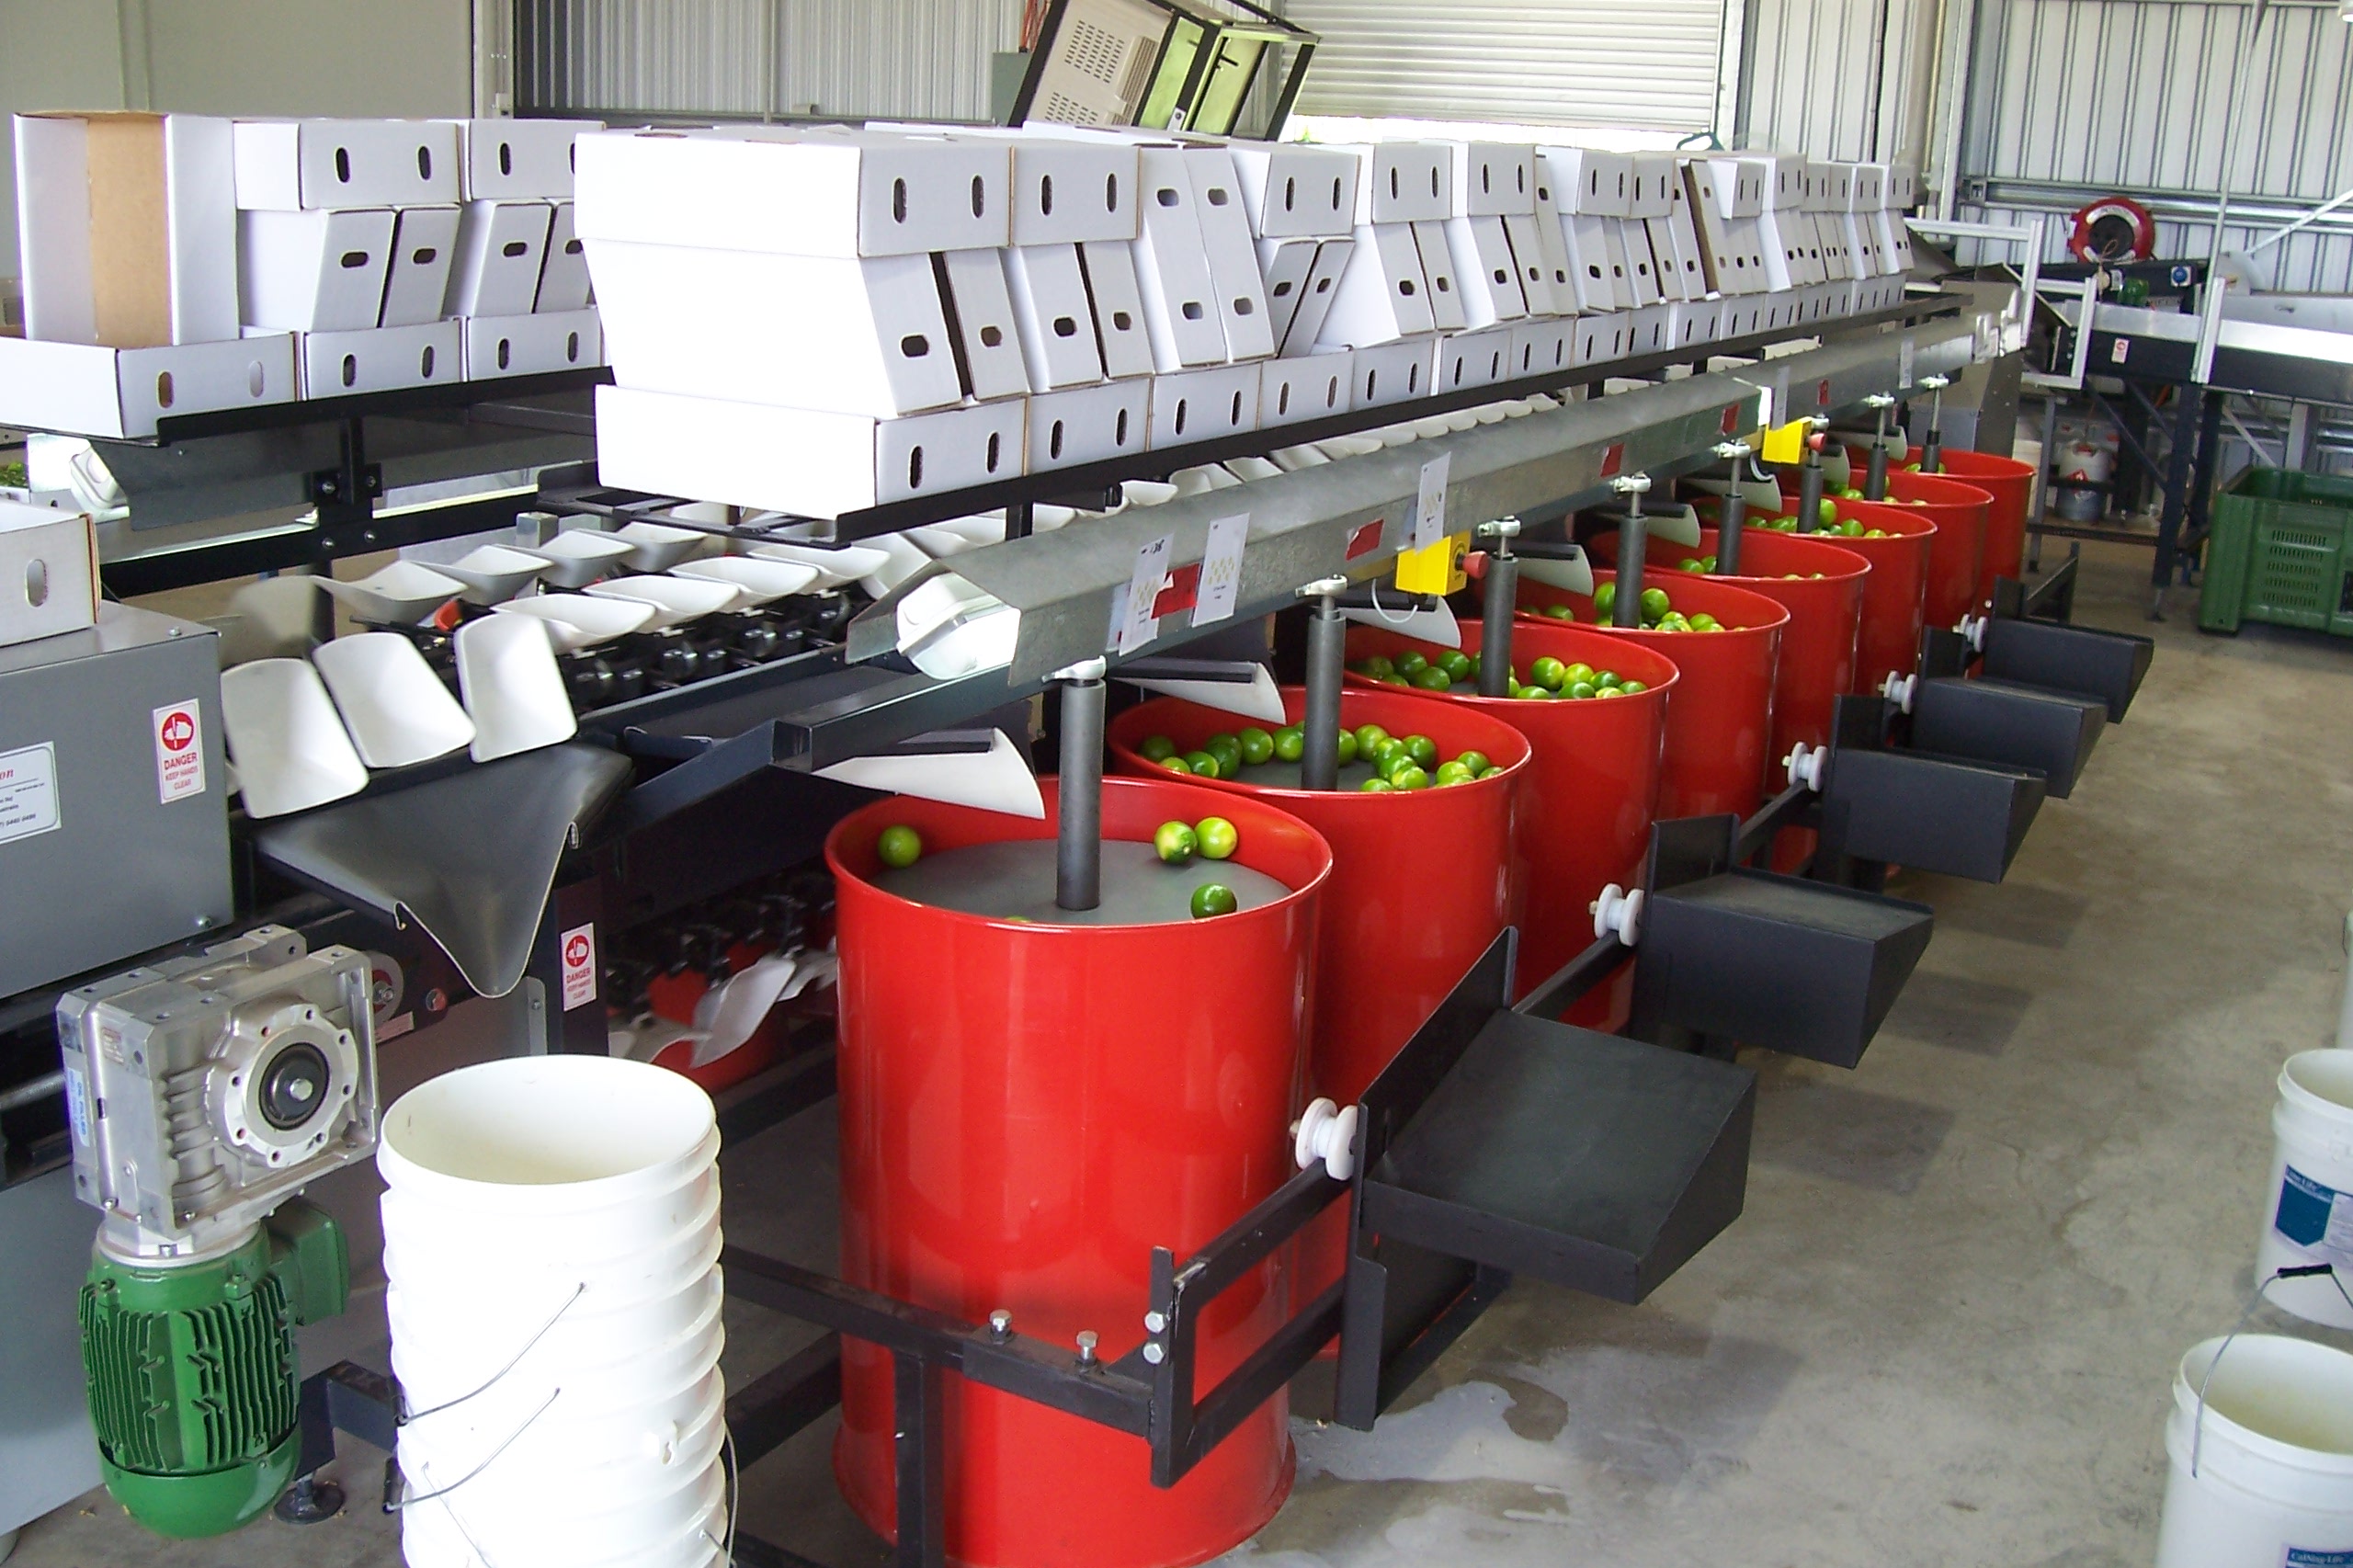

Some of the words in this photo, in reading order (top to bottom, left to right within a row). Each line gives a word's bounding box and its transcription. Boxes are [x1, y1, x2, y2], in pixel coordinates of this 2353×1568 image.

[164, 752, 198, 770] DANGER
[165, 770, 179, 781] KEEP
[179, 765, 199, 777] HANDS
[174, 778, 192, 790] CLEAR
[566, 967, 590, 983] DANGER
